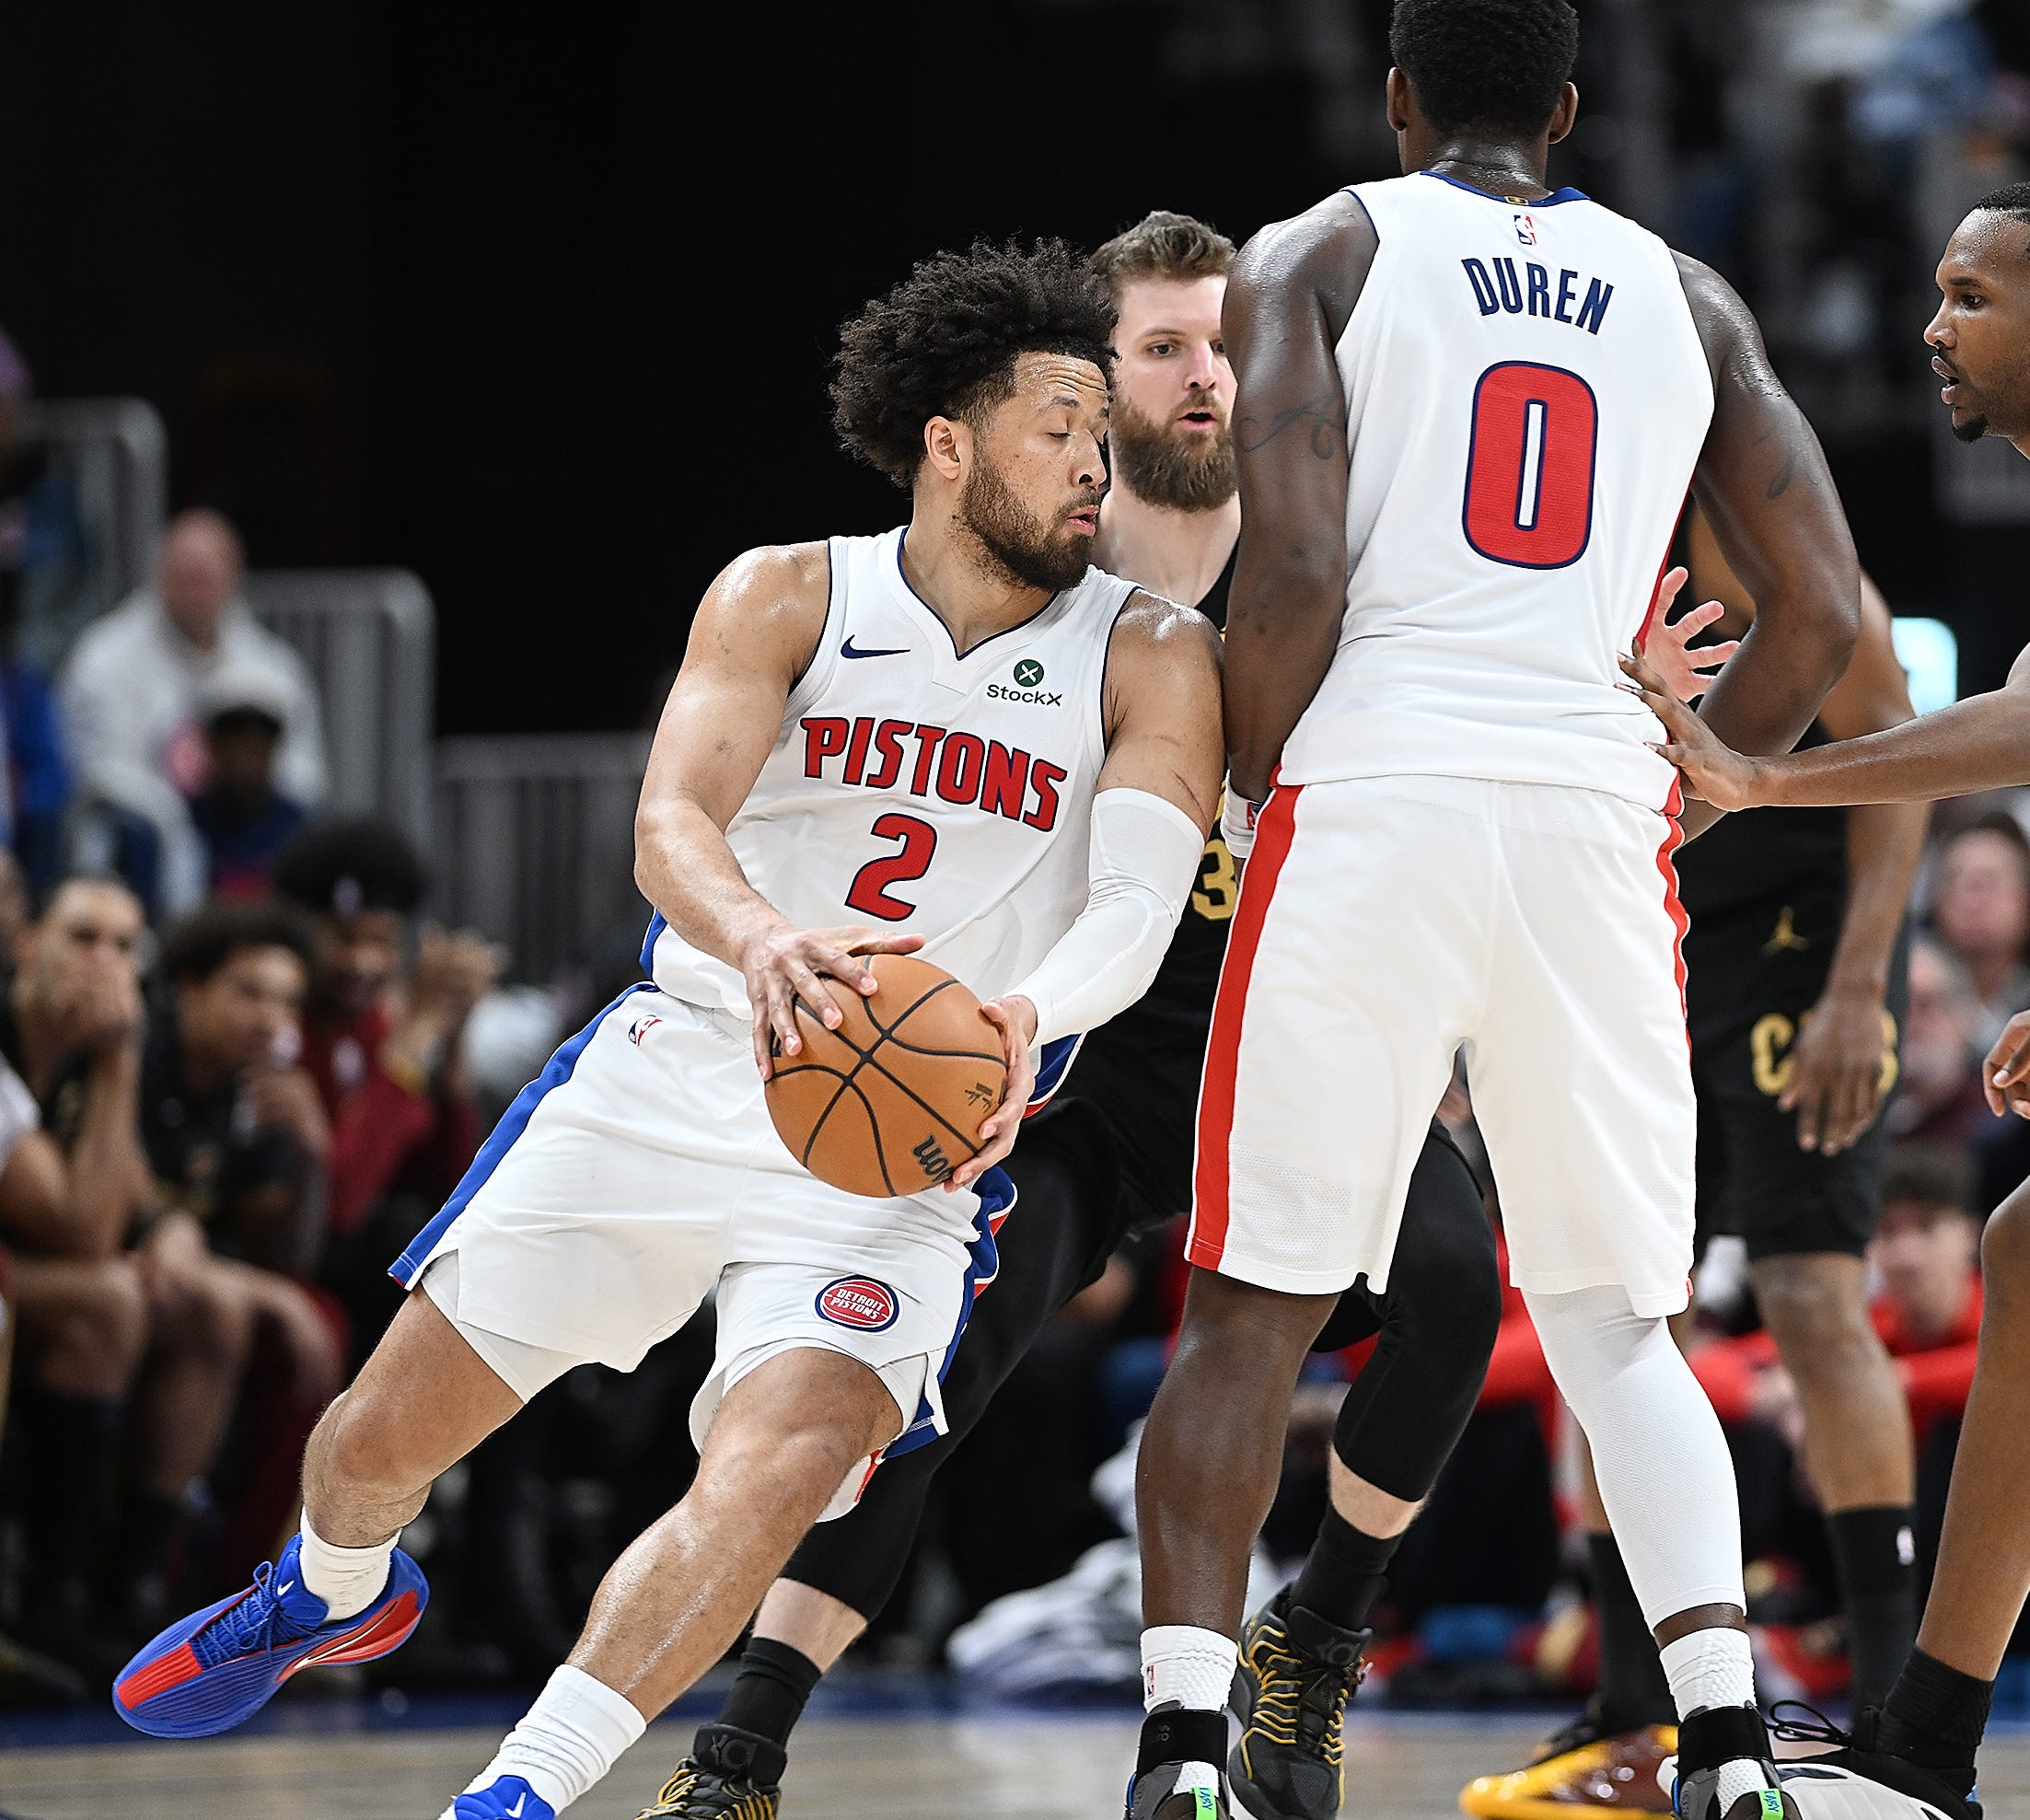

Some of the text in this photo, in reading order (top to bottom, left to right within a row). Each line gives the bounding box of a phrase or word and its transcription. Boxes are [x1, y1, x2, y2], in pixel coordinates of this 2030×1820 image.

[1461, 258, 1614, 335] DUREN
[1462, 360, 1598, 570] 0
[987, 684, 1062, 707] StockX
[800, 717, 1068, 832] PISTONS
[844, 813, 938, 922] 2
[829, 1296, 880, 1320] PISTONS
[836, 1289, 886, 1312] DETROIT
